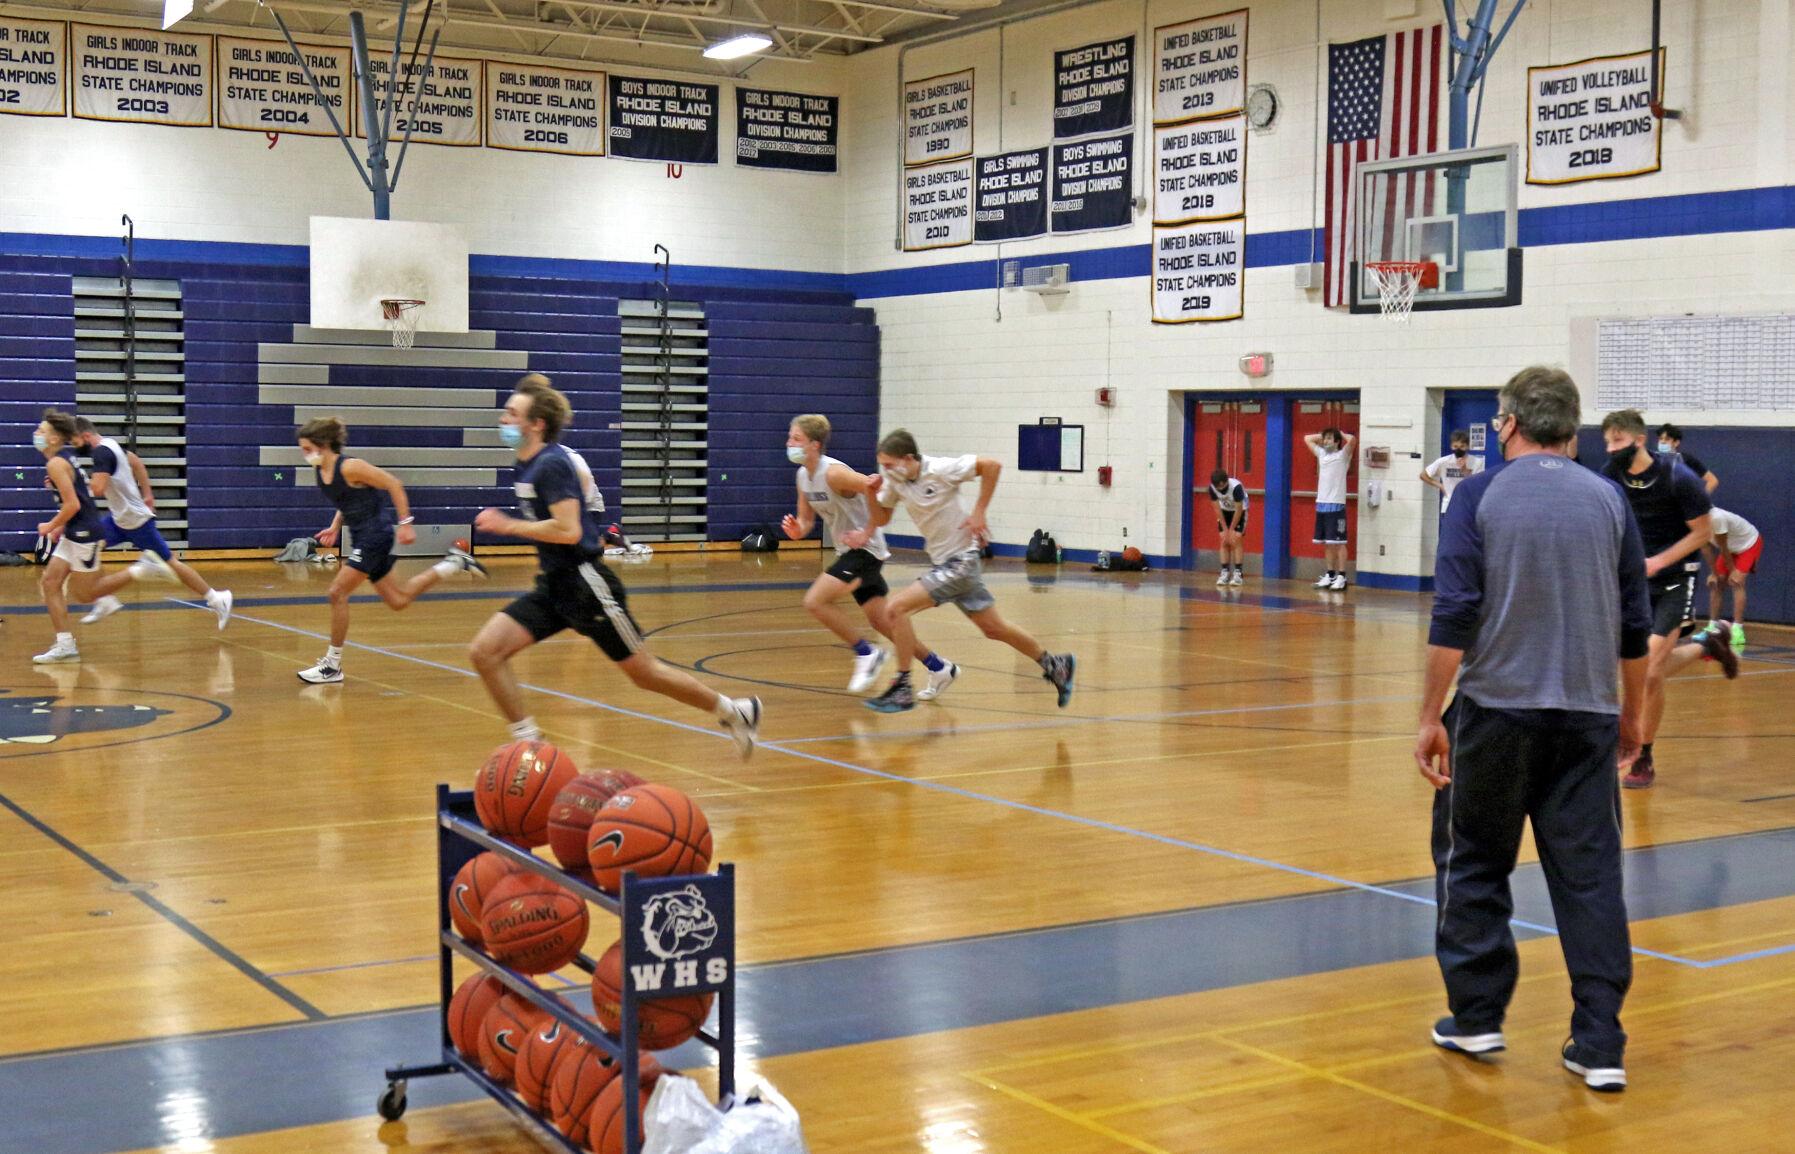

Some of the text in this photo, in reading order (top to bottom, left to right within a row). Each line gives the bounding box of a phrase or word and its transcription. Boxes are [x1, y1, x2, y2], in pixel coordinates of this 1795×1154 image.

[15, 29, 50, 44] TRACK
[87, 35, 197, 57] GIRLS INDOOR TRACK
[1163, 24, 1237, 51] UNIFIED BASKETBALL
[0, 48, 55, 65] SLAND
[232, 47, 261, 62] GIRLS
[305, 54, 337, 69] TRACK
[1062, 42, 1126, 68] WRESTLING
[1162, 44, 1238, 72] RHODE ISLAND
[0, 68, 56, 85] AMPIONS
[83, 55, 201, 77] RHODE ISLAND
[229, 66, 281, 83] RHODE
[370, 60, 397, 74] GIRL
[439, 66, 468, 81] TRACK
[1059, 59, 1129, 85] RHODE ISLAND
[82, 75, 203, 97] STATE CHAMPIONS
[500, 72, 592, 92] GIRLS INDOOR TRACK
[1158, 65, 1239, 92] STATE CHAMPIONS
[1540, 66, 1648, 97] UNIFIED VOLLEYBALL
[227, 86, 267, 102] STATE
[423, 83, 472, 99] SLAND
[496, 89, 595, 110] RHODE ISLAND
[621, 81, 707, 100] BOYS INDOOR TRACK
[906, 80, 971, 103] GIRLS BASKETBALL
[1062, 78, 1125, 103] DIVISION CHAMPIONS
[1182, 91, 1214, 110] 2013
[117, 98, 169, 113] 2003
[616, 96, 712, 116] RHODE ISLAND
[745, 92, 829, 111] GIRLS INDOOR TRACK
[910, 98, 968, 120] RHODE ISLAND
[1538, 90, 1651, 122] RHODE ISLAND
[260, 108, 309, 124] 2004
[494, 108, 598, 128] STATE CHAMPIONS
[622, 112, 706, 131] DIVISION CHAMPIONS
[743, 107, 832, 126] RHODE ISLAND
[524, 129, 568, 144] 2006
[747, 123, 828, 141] DIVISION CHAMPIONS
[909, 116, 968, 138] STATE CHAMPIONS
[1535, 115, 1652, 147] STATE CHAMPIONS
[1162, 127, 1236, 151] UNIFIED BASKETBALL
[1063, 140, 1122, 161] BOYS SWIMMING
[1161, 148, 1238, 172] RHODE ISLAND
[1568, 147, 1613, 168] 2018
[983, 153, 1040, 174] GIRLS SWIMMING
[1058, 156, 1127, 179] RHODE ISLAND
[906, 169, 970, 189] GIRLS BASKETBALL
[979, 169, 1043, 191] RHODE ISLAND
[1061, 175, 1122, 196] DIVISION CHAMPIONS
[1160, 169, 1238, 192] STATE CHAMPIONS
[909, 187, 967, 206] RHODE ISLAND
[981, 187, 1039, 207] DIVISION CHAMPIONS
[1182, 194, 1214, 211] 2018
[908, 205, 968, 224] STATE CHAMPIONS
[926, 225, 950, 240] 2010
[1160, 230, 1236, 251] UNIFIED BASKETBALL
[1159, 251, 1237, 271] RHODE ISLAND
[1157, 272, 1237, 292] STATE CHAMPIONS
[1182, 295, 1211, 311] 2019
[488, 905, 560, 935] SPALDING
